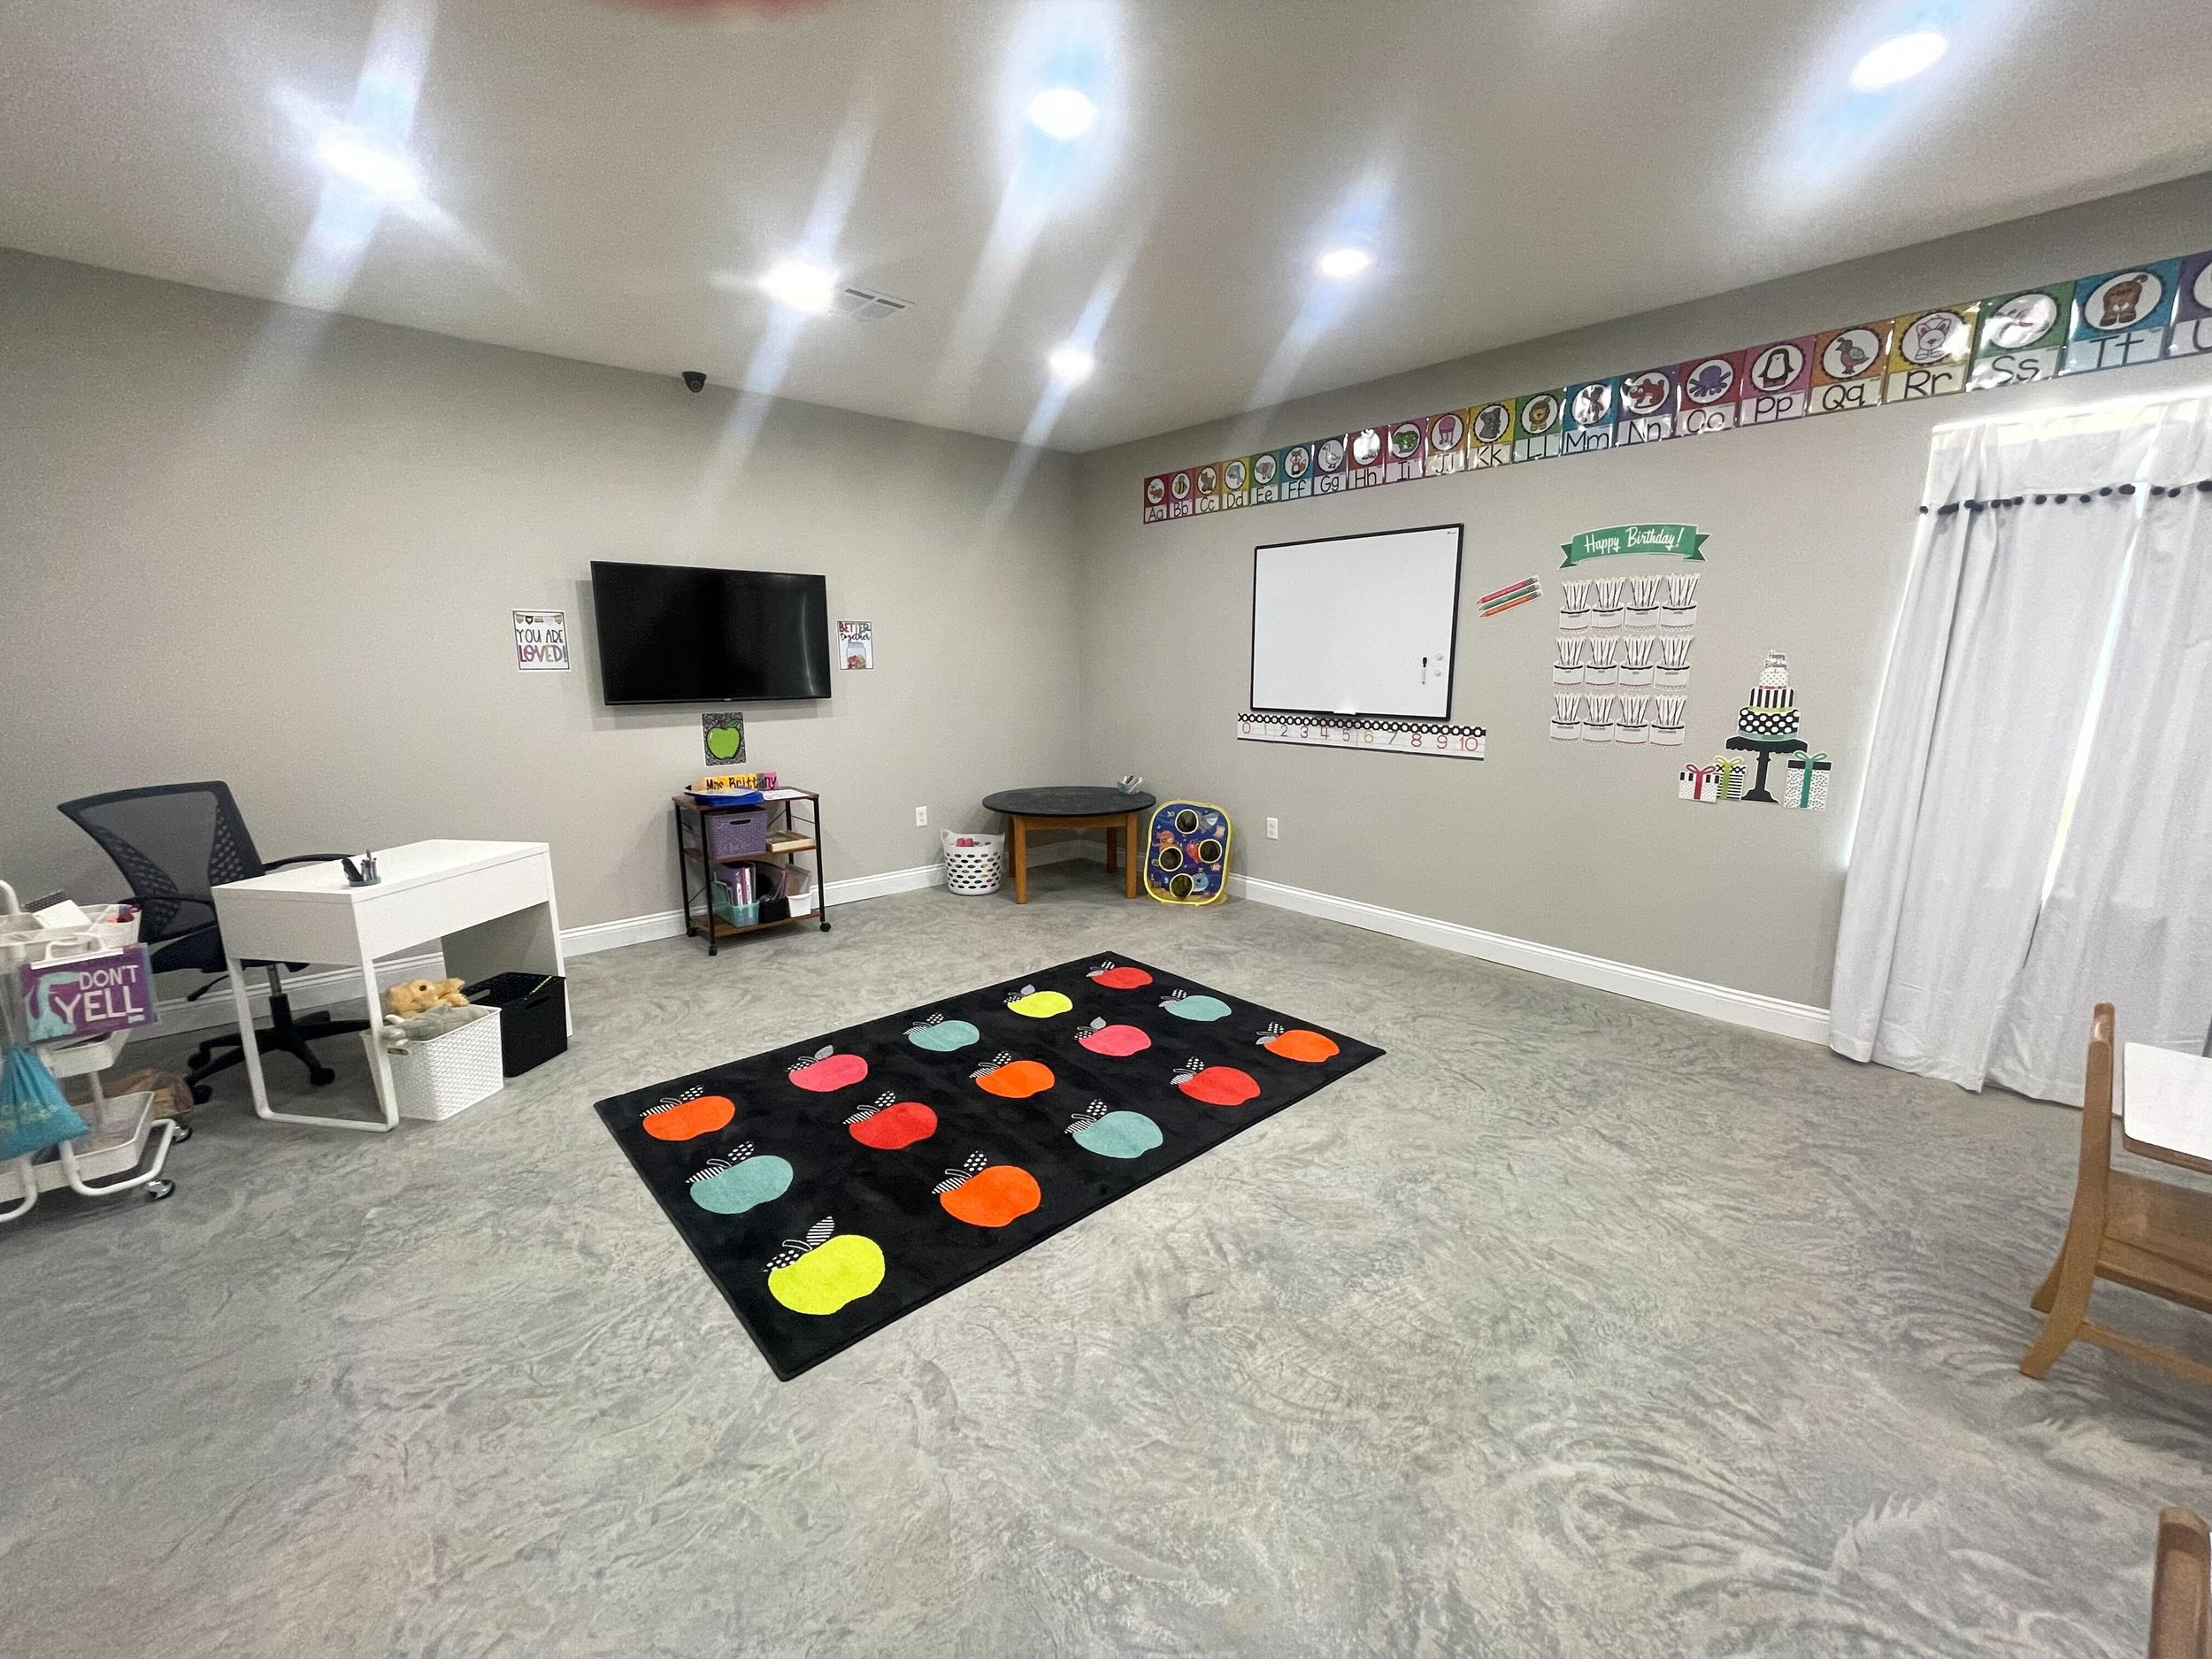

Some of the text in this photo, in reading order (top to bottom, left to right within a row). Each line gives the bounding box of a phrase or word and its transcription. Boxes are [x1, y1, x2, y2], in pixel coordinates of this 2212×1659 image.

[1148, 507, 1164, 522] Aa
[1173, 503, 1189, 516] Bb
[1200, 498, 1215, 512] Cc
[1226, 493, 1243, 507] Dd
[1256, 488, 1273, 503] Ee
[1288, 480, 1307, 496] Ff
[1319, 475, 1340, 493] Gg
[1355, 469, 1377, 488] Hh
[1396, 462, 1411, 482] Ii
[1476, 446, 1503, 468] Kk
[1526, 435, 1548, 459] Ll
[1565, 431, 1610, 453] Mm
[1628, 420, 1662, 443] Nn
[1686, 409, 1725, 433] Oo
[1822, 382, 1866, 411] Qq
[1903, 370, 1953, 399] Rr
[1991, 355, 2040, 383] Ss
[2089, 332, 2145, 369] Tt
[1584, 526, 1685, 555] Happy Birthday!
[516, 629, 564, 643] YOU ARE
[839, 621, 871, 633] BETTER
[518, 644, 567, 663] LOVED!
[1241, 722, 1251, 734] 0
[1280, 725, 1288, 737] 2
[1300, 726, 1309, 739] 3
[1320, 726, 1329, 740] 4
[1342, 727, 1351, 741] 5
[1363, 730, 1374, 744] 6
[1386, 731, 1398, 745] 7
[1410, 733, 1422, 747] 8
[1436, 734, 1448, 749] 9
[1458, 735, 1479, 751] 10
[80, 964, 139, 990] DON'T
[54, 986, 144, 1024] YELL
